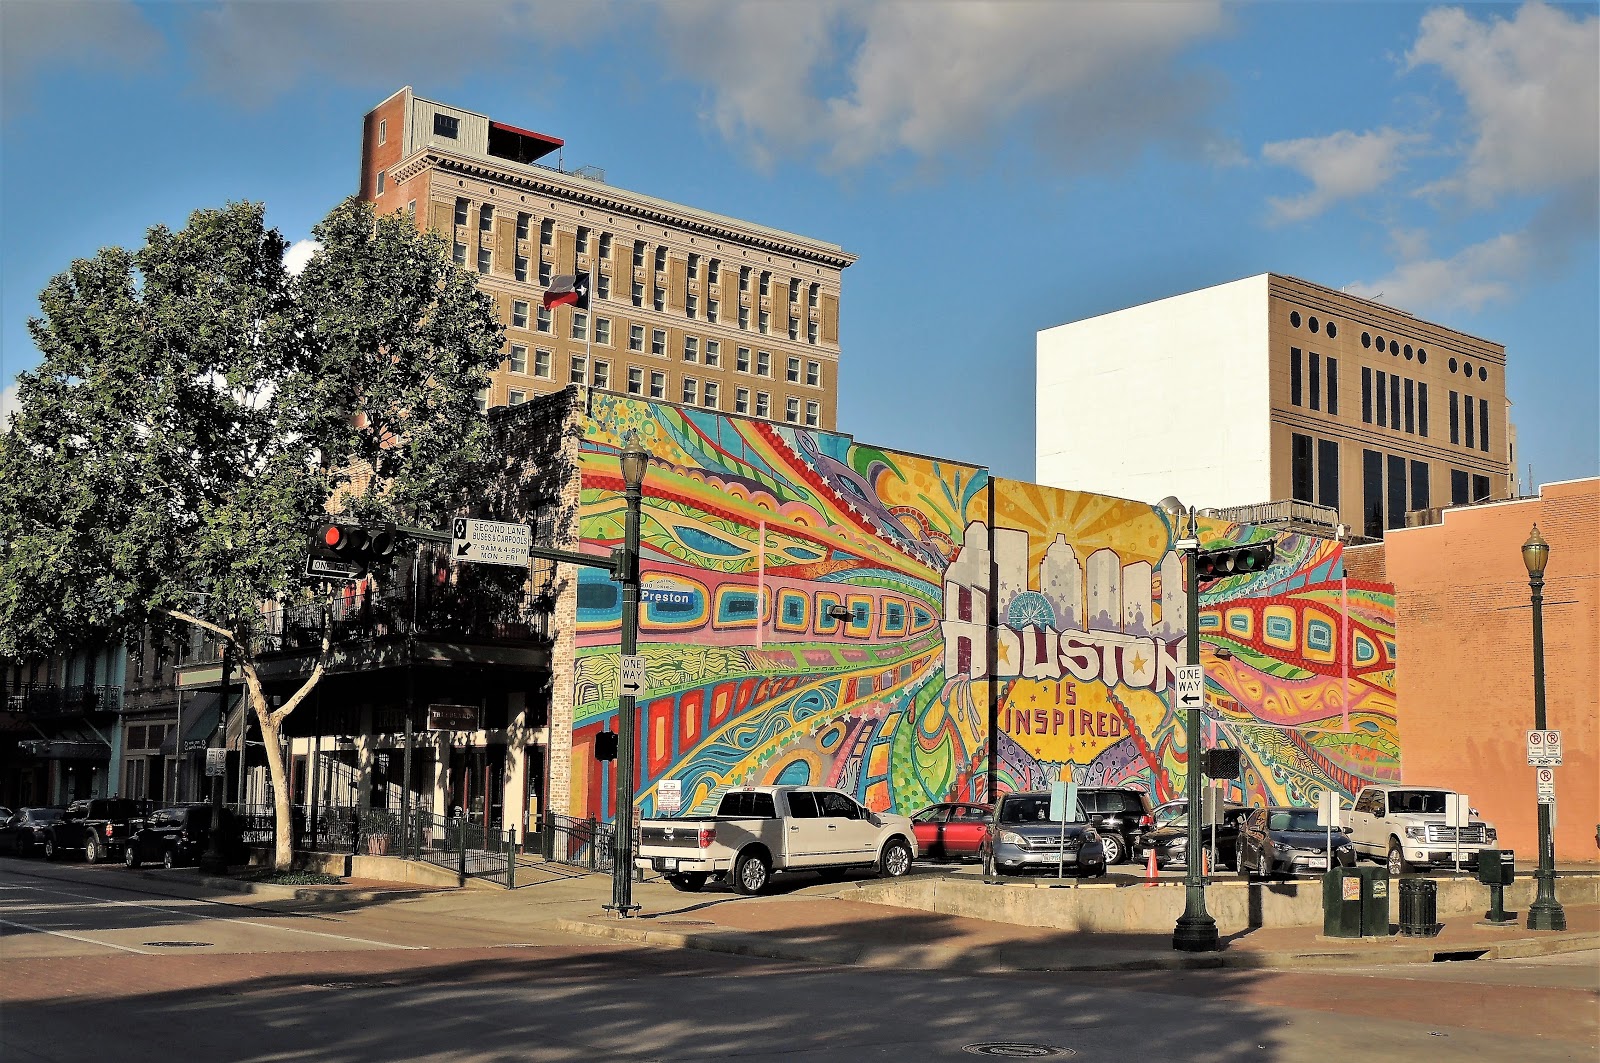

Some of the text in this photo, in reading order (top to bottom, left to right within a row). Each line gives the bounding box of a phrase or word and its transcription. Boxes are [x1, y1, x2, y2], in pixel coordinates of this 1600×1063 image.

[475, 523, 526, 535] SECOND LANE
[641, 590, 689, 603] Preston
[941, 580, 1187, 691] HOUSTON
[624, 659, 641, 669] ONE
[623, 670, 642, 679] WAY
[1179, 669, 1200, 680] ONE
[1178, 680, 1201, 691] WAY
[1055, 682, 1077, 705] IS
[1005, 708, 1122, 737] INSPIRED
